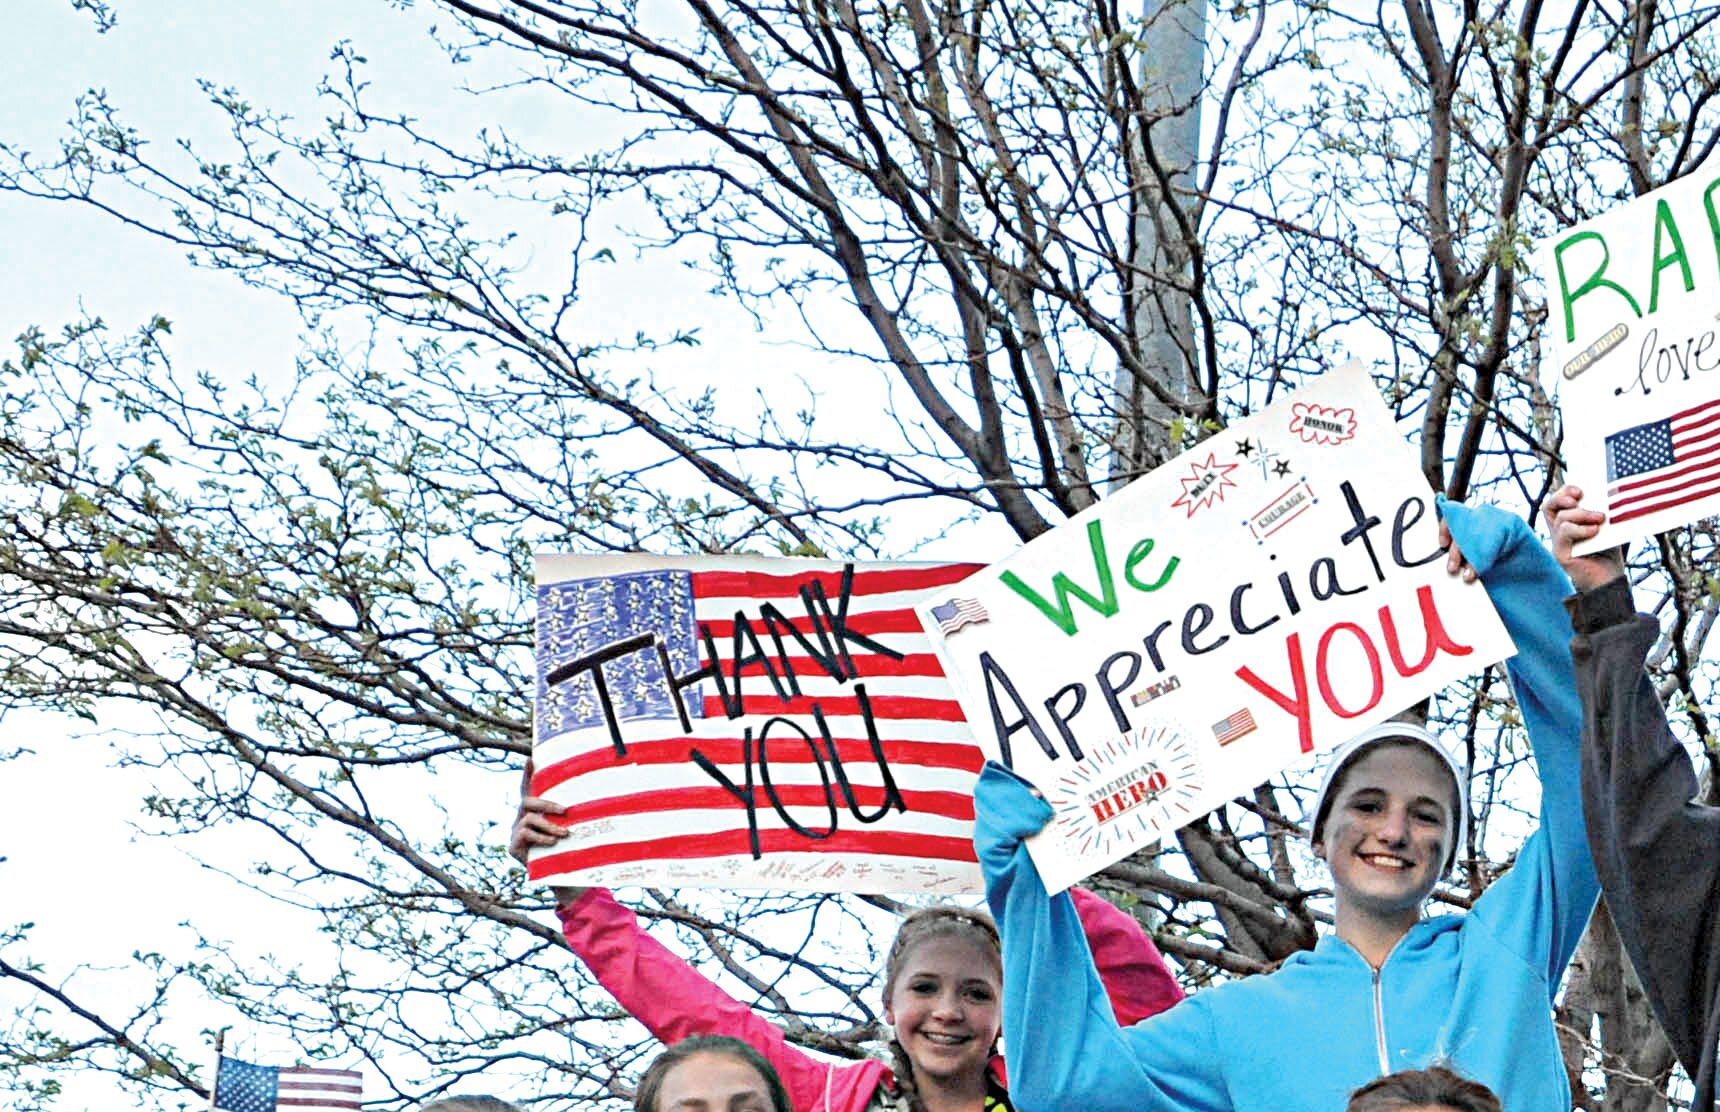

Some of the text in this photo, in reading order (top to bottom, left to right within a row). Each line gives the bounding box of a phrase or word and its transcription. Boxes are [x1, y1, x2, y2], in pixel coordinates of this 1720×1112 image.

[1303, 416, 1345, 434] HONOR
[1257, 491, 1307, 529] COURAGE
[998, 518, 1181, 638] We
[545, 563, 905, 758] THANK
[978, 479, 1450, 766] Appreciate
[689, 683, 907, 861] YOU
[1086, 760, 1159, 803] AMERICAN
[1091, 771, 1168, 823] HERO
